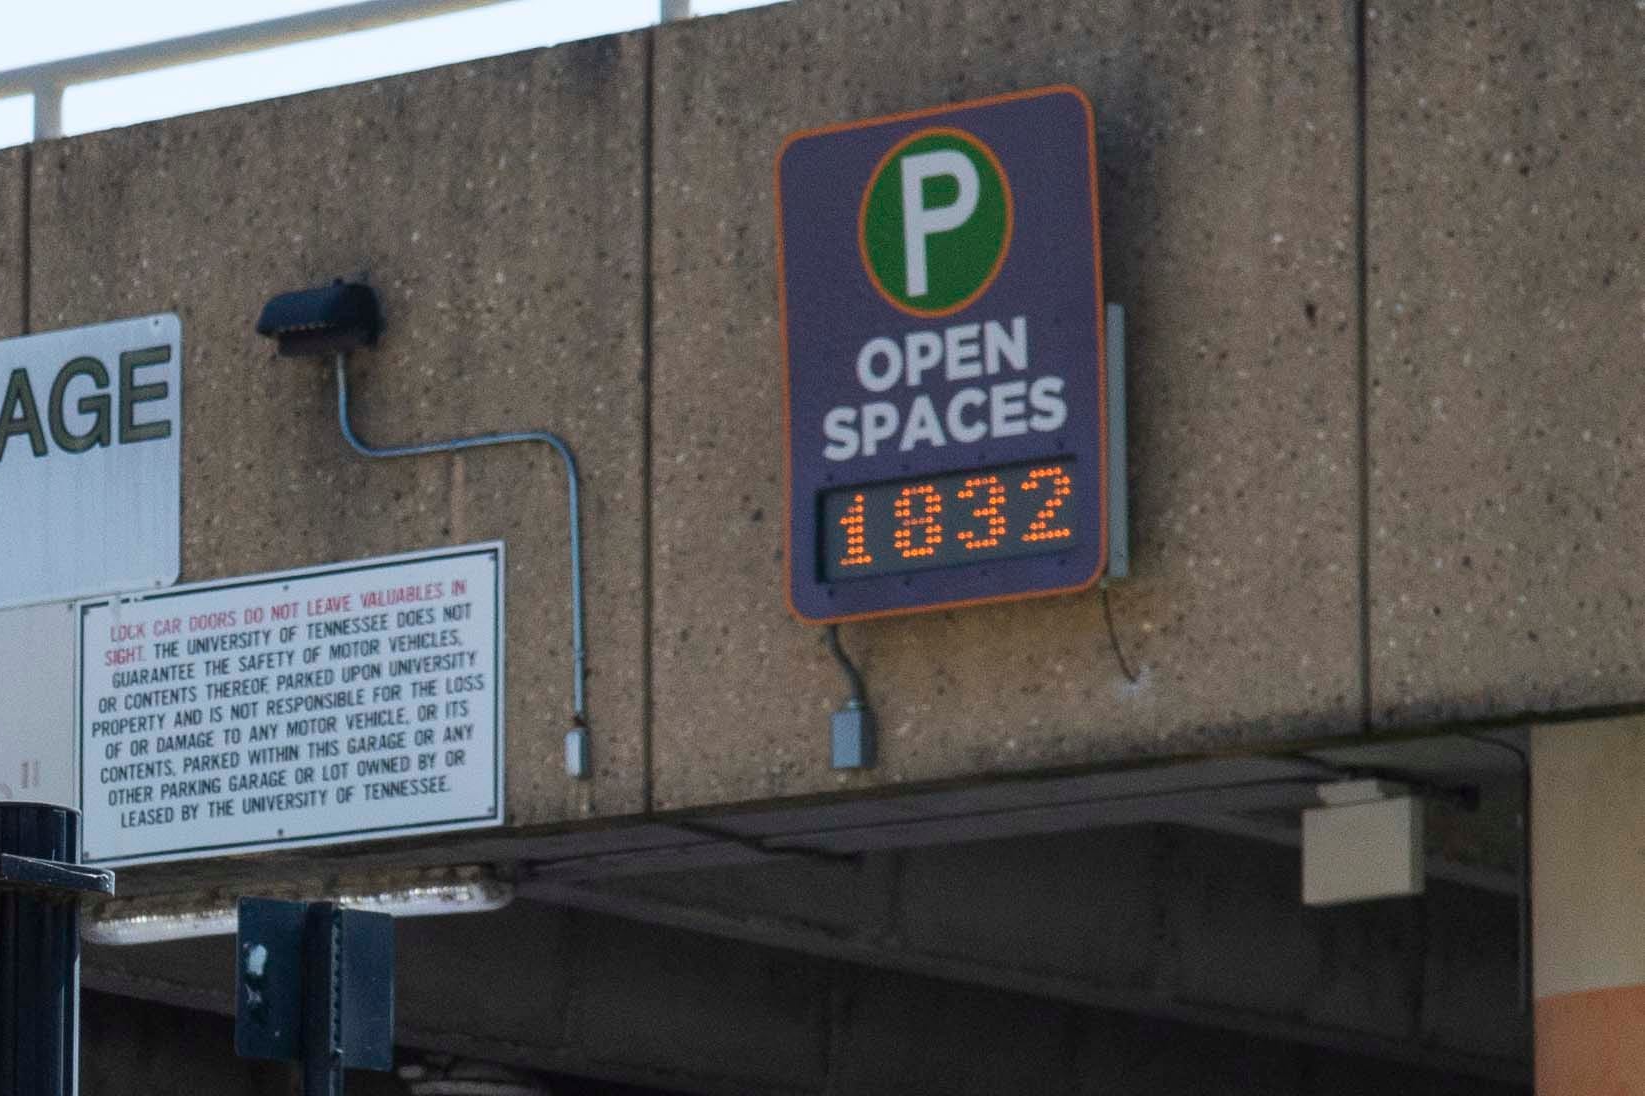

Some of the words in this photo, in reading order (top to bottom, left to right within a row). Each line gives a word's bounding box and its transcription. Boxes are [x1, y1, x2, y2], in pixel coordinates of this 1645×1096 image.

[901, 150, 980, 297] P
[856, 316, 1027, 392] OPEN
[823, 376, 1067, 461] SPACES
[110, 622, 146, 642] LOCK
[153, 618, 181, 637] CAR
[189, 610, 236, 632] DOORS
[244, 607, 263, 625] DO
[271, 602, 299, 620] NOT
[307, 595, 351, 617] LEAVE
[360, 583, 445, 608] VALUABLES
[451, 579, 467, 596] IN
[154, 641, 179, 659] THE
[187, 629, 272, 654] UNIVERSITY
[279, 625, 298, 643] OF
[307, 613, 389, 640] TENNESSEE
[397, 608, 435, 628] DOES
[443, 602, 472, 622] NOT
[98, 697, 117, 714] OR
[124, 685, 198, 711] CONTENTS
[276, 668, 335, 691] PARKED
[341, 663, 381, 684] UPON
[389, 651, 477, 677] UNIVERSITY
[112, 663, 195, 689] GUARANTEE
[205, 658, 229, 677] THE
[238, 650, 295, 673] SAFETY
[303, 647, 321, 665] OF
[329, 638, 380, 661] MOTOR
[91, 713, 166, 738] PROPERTY
[174, 709, 203, 728] AND
[210, 706, 223, 723] IS
[230, 702, 258, 720] NOT
[266, 688, 366, 717] RESPONSIBLE
[373, 684, 402, 703] FOR
[411, 680, 437, 699] THE
[446, 674, 485, 694] LOSS
[105, 742, 122, 760] OF
[130, 739, 149, 757] OR
[157, 730, 214, 752] DAMAGE
[223, 727, 241, 745] TO
[248, 723, 278, 742] ANY
[286, 716, 337, 737] MOTOR
[418, 703, 438, 722] OR
[445, 700, 469, 718] ITS
[108, 785, 153, 806] OTHER
[161, 777, 222, 799] PARKING
[228, 769, 287, 791] GARAGE
[294, 766, 314, 785] OR
[322, 762, 350, 782] LOT
[357, 755, 411, 777] OWNED
[418, 751, 437, 771] BY
[445, 749, 466, 767] OR
[183, 751, 240, 773] PARKED
[247, 744, 300, 766] WITHIN
[307, 739, 340, 759] THIS
[346, 731, 406, 754] GARAGE
[414, 728, 434, 746] OR
[443, 723, 475, 742] ANY
[121, 806, 175, 829] LEASED
[181, 803, 200, 822] BY
[207, 799, 235, 819] THE
[242, 789, 328, 814] UNIVERSITY
[336, 785, 355, 805] OF
